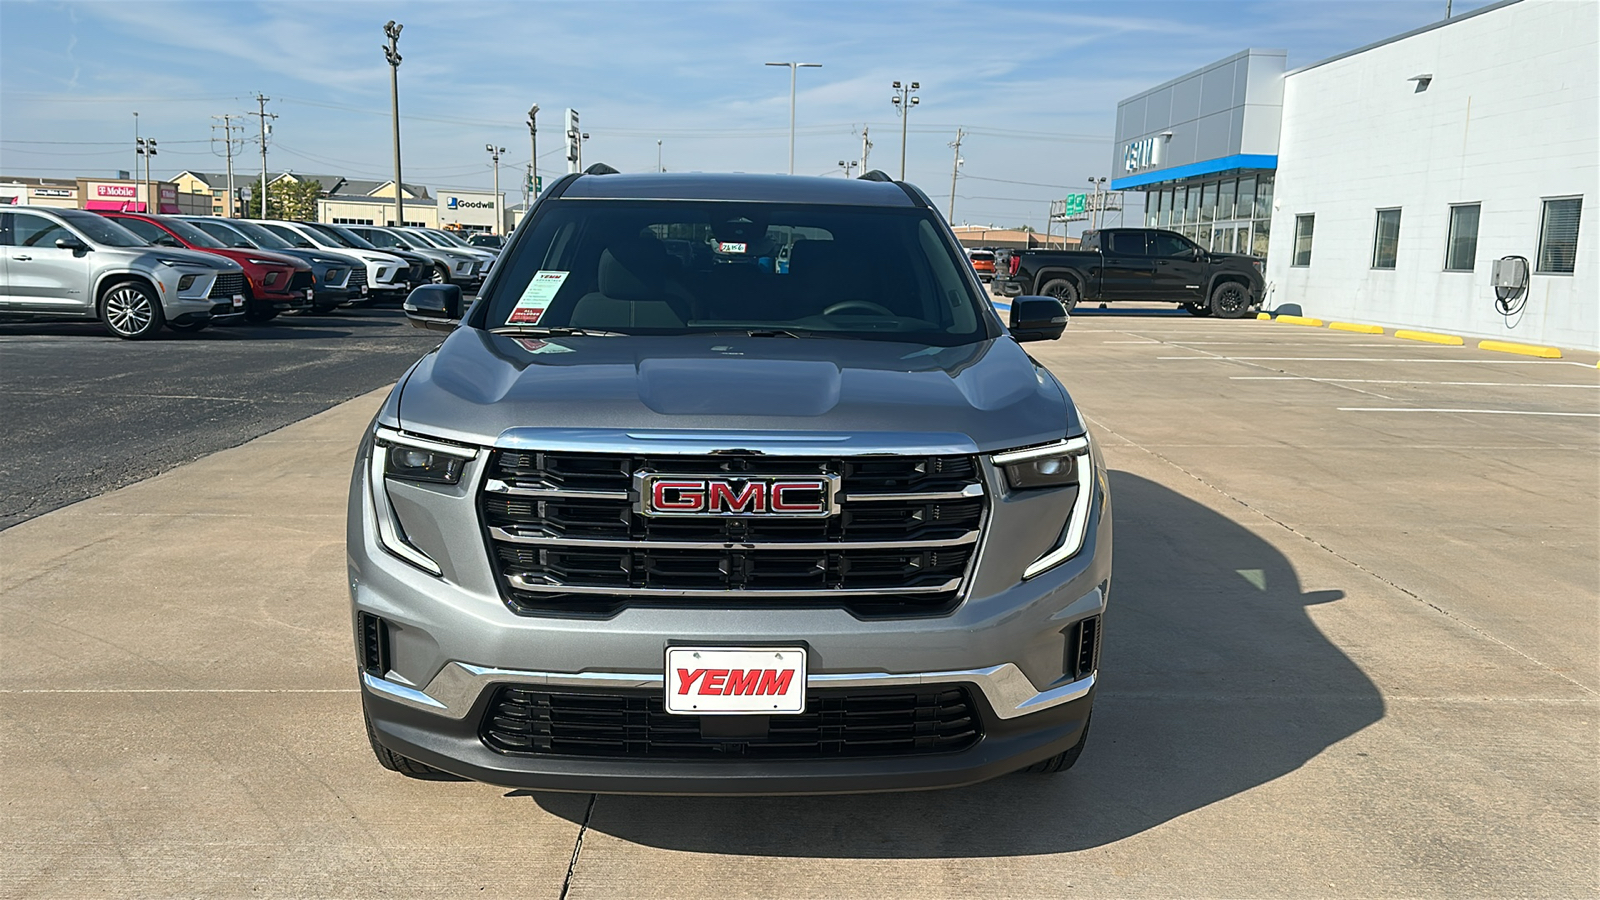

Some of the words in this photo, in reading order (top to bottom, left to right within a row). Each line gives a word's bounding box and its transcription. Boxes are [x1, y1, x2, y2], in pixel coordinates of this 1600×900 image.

[107, 186, 134, 196] Mobile
[458, 200, 494, 209] Goodwill
[653, 480, 823, 512] GMC
[677, 668, 795, 695] YEMM
